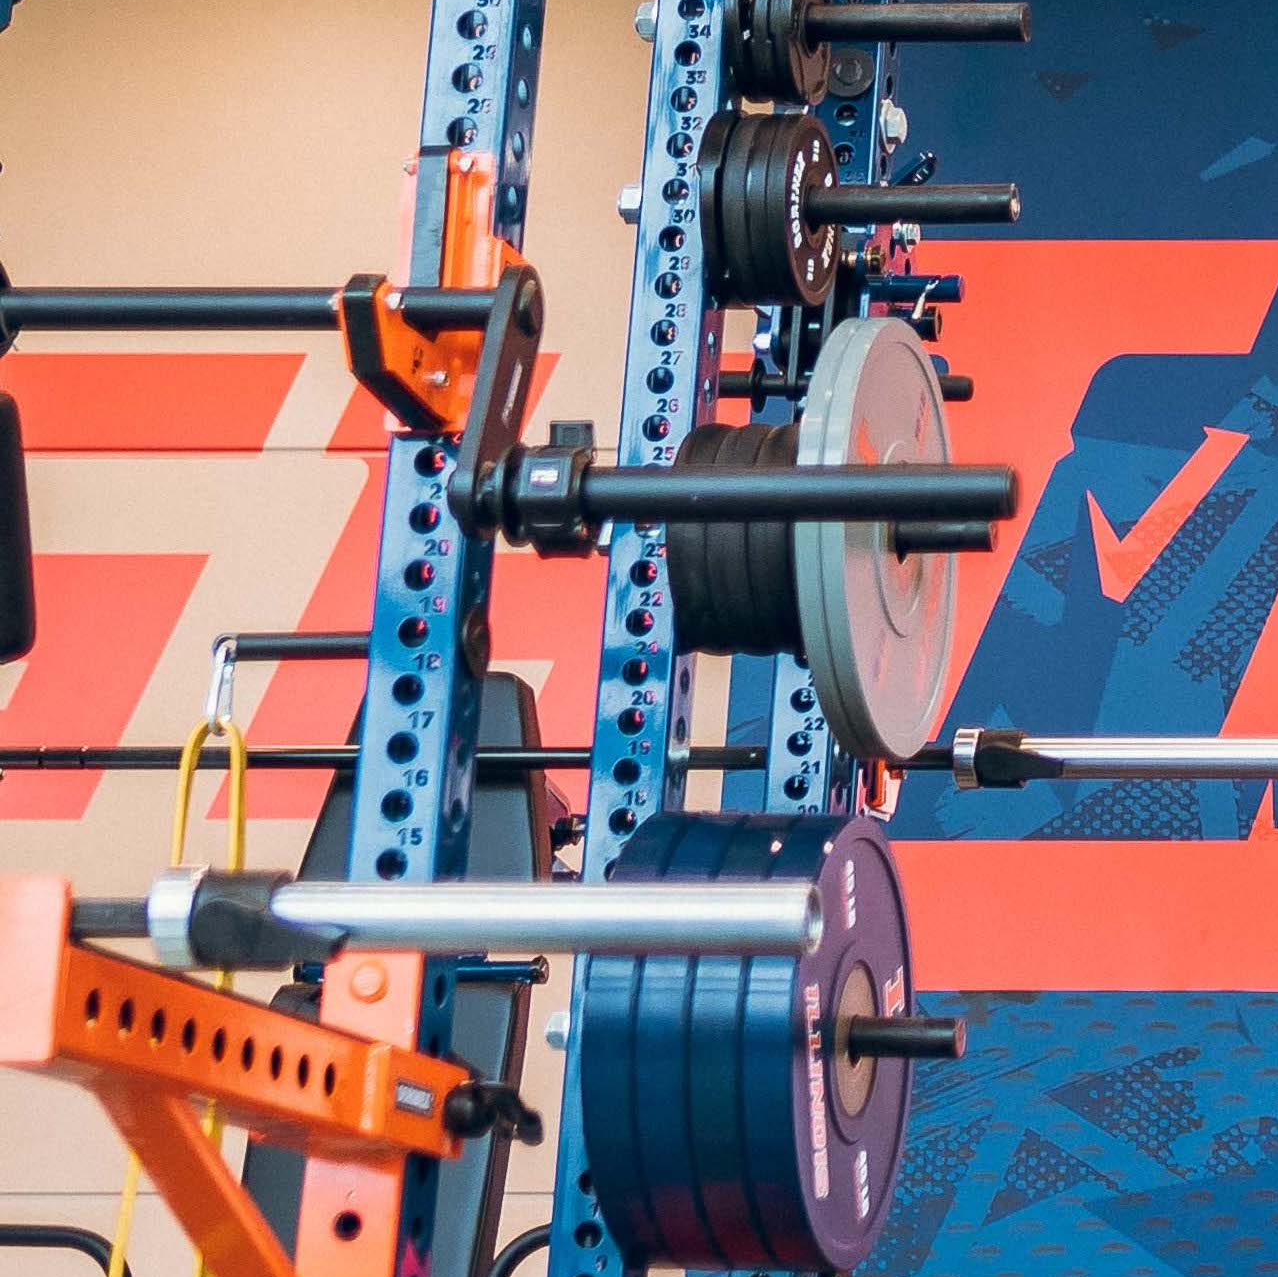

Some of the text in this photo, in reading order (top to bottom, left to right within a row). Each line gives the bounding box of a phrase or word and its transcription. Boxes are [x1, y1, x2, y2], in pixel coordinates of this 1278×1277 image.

[689, 24, 711, 38] 34
[472, 45, 497, 60] 29
[681, 116, 703, 130] 32
[673, 210, 695, 224] 30
[669, 258, 690, 271] 29
[665, 304, 687, 317] 28
[661, 352, 681, 365] 27
[656, 399, 679, 413] 26
[653, 447, 673, 461] 25
[424, 539, 451, 556] 20
[421, 596, 449, 613] 19
[641, 592, 664, 606] 22
[414, 653, 441, 671] 18
[631, 690, 656, 705] 20
[408, 711, 435, 729] 17
[804, 718, 825, 731] 22
[801, 762, 820, 774] 21
[402, 769, 429, 787] 16
[397, 828, 423, 846] 15
[805, 983, 830, 1200] ILLINOIS
